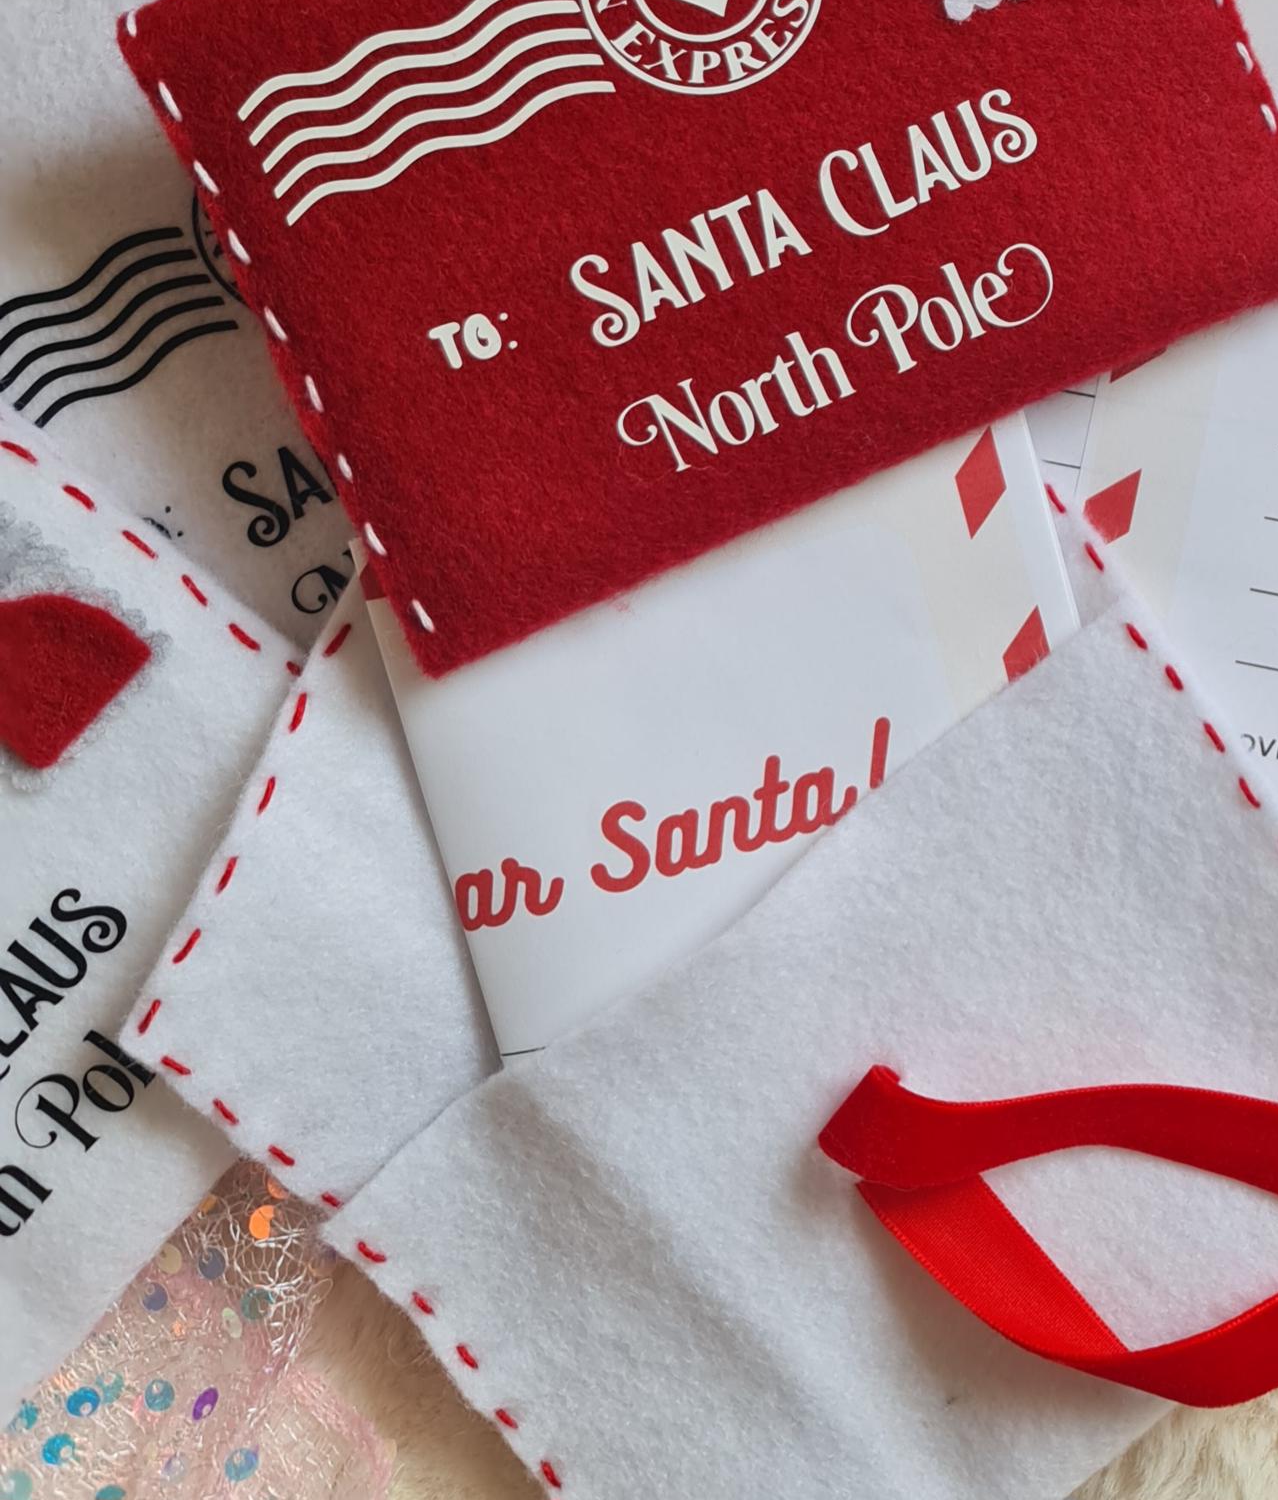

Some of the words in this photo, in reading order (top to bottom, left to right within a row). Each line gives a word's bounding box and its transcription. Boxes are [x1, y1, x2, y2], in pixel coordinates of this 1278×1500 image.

[570, 188, 812, 347] SANTA
[819, 88, 1038, 238] CLAUS
[428, 311, 519, 370] TO:
[616, 331, 856, 473] North
[846, 242, 1054, 375] Pole
[590, 717, 890, 893] Santa!
